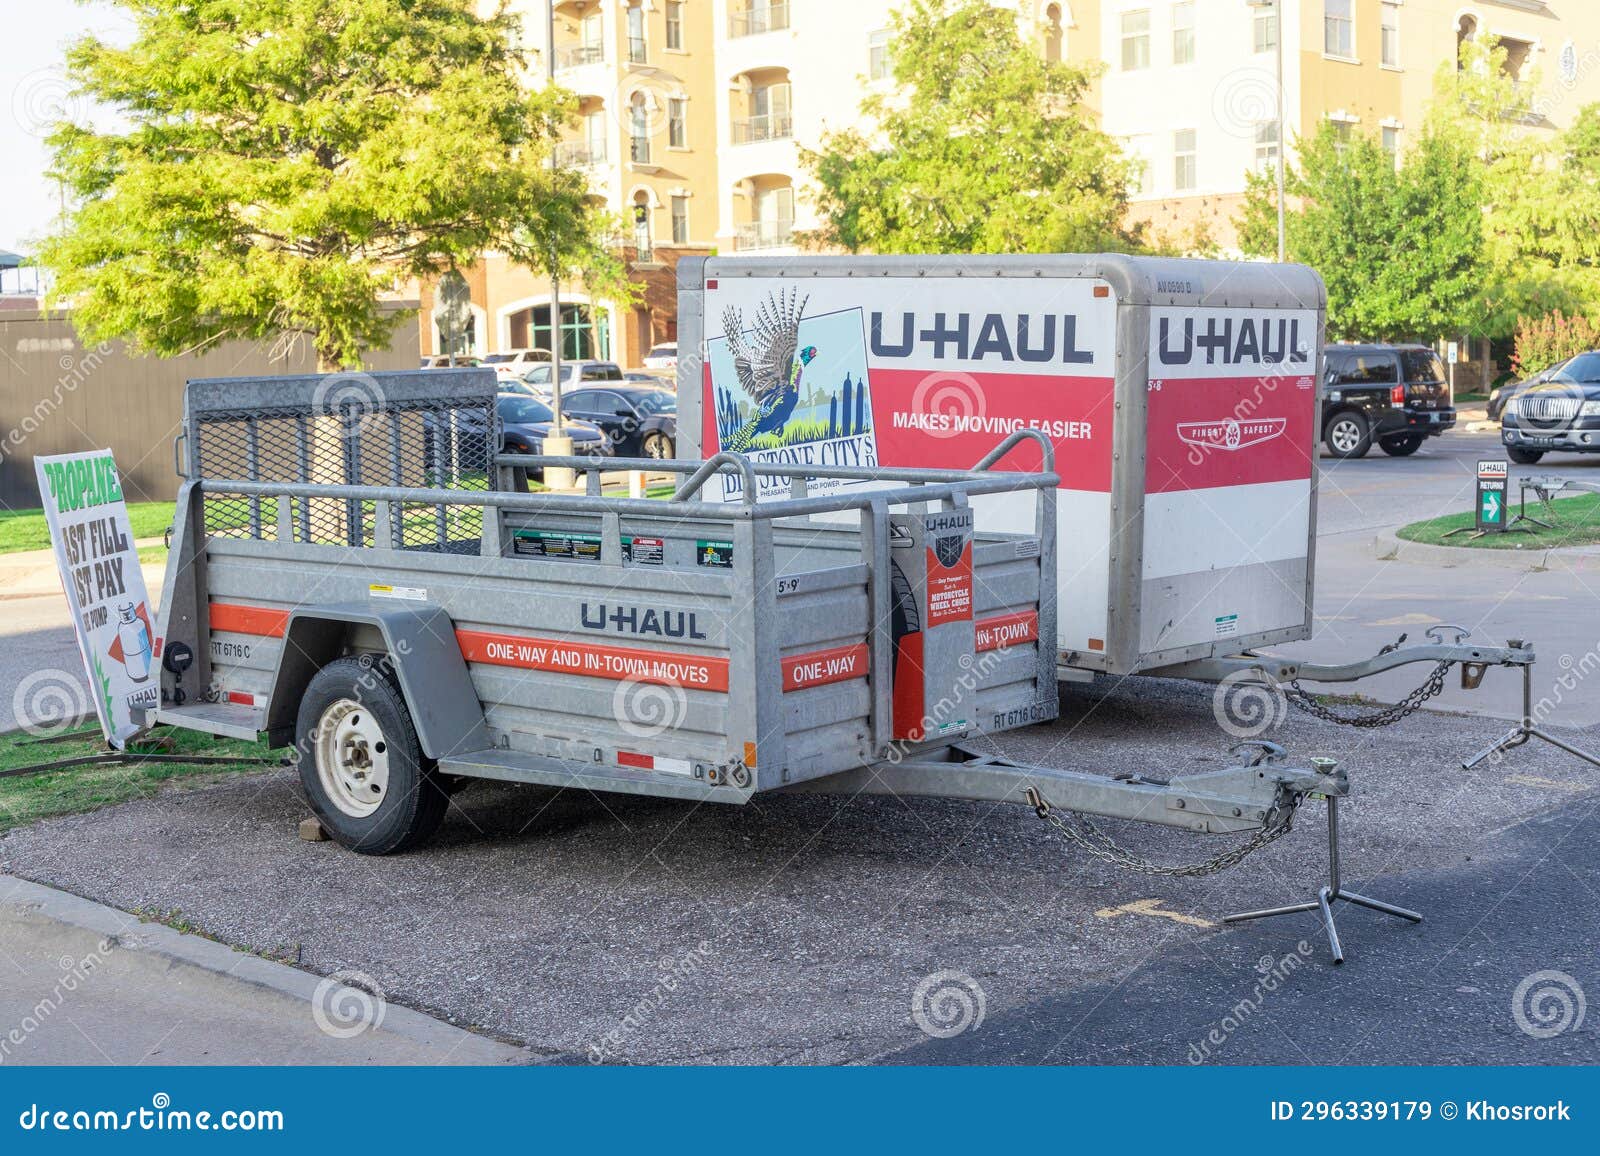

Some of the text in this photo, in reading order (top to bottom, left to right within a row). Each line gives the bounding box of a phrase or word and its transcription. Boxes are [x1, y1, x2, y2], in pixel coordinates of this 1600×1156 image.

[870, 311, 1094, 364] U-HAUL
[1159, 317, 1308, 365] U-HAUL
[892, 411, 1092, 440] MAKES MOVING EASIER
[1244, 425, 1273, 434] SAFEST
[820, 481, 840, 489] POWER
[1480, 481, 1504, 490] RETURNS
[926, 515, 972, 531] U-HAUL
[88, 516, 129, 558] FILL
[94, 557, 126, 600] PAY
[930, 601, 950, 611] WHEEL
[932, 590, 969, 602] MOTORCYCLE
[90, 606, 107, 630] PUMP
[581, 603, 707, 640] U-HAUL
[976, 621, 1029, 646] IN-TOWN
[224, 643, 242, 658] 6716
[244, 645, 250, 658] C
[487, 642, 709, 684] ONE-WAY AND IN-TOWN MOVES
[793, 655, 856, 683] ONE-WAY
[994, 712, 1006, 728] RT
[1008, 707, 1028, 726] 6716
